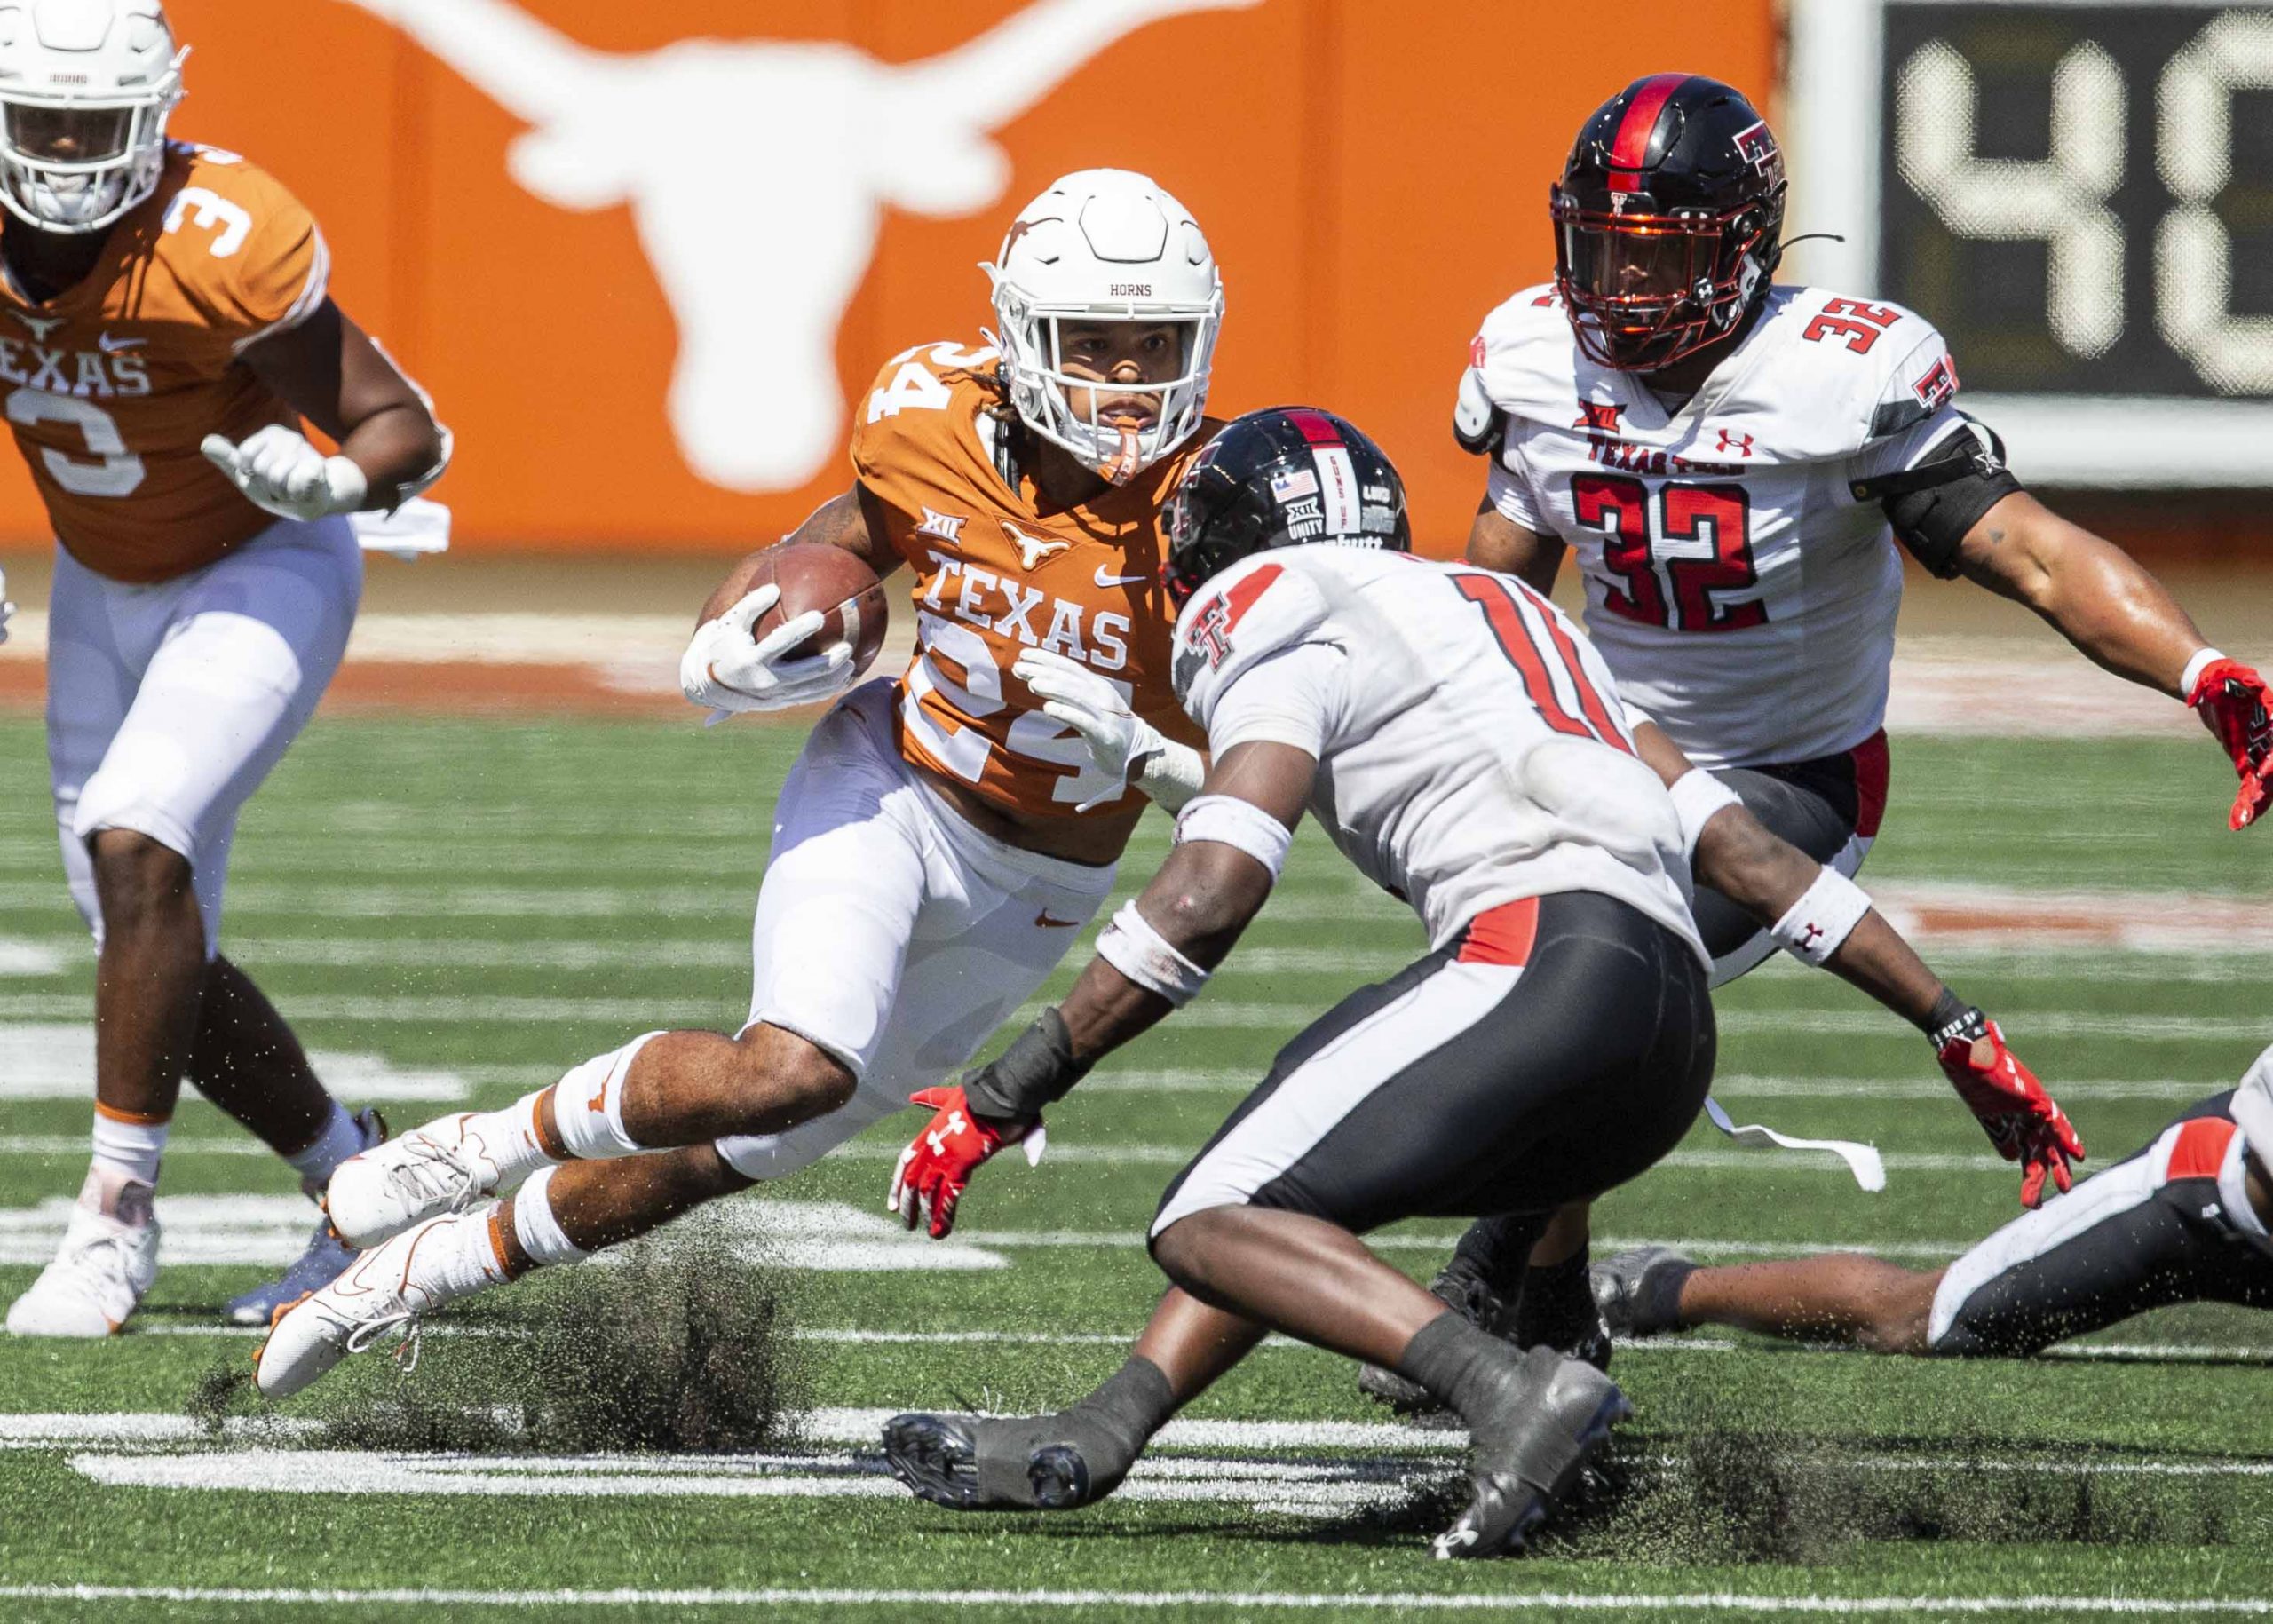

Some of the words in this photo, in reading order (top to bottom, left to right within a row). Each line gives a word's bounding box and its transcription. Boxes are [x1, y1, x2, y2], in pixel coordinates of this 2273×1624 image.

[162, 186, 252, 259] 3
[1110, 284, 1152, 297] HORNS
[1802, 297, 1903, 355] 32
[0, 336, 152, 396] EXAS
[6, 388, 147, 497] 3
[1587, 433, 1667, 476] TEXAS
[1287, 519, 1324, 541] UNITY
[1570, 471, 1769, 632] 32
[923, 550, 1130, 671] TEXAS
[1443, 573, 1639, 758] 11
[899, 609, 1134, 804] 24
